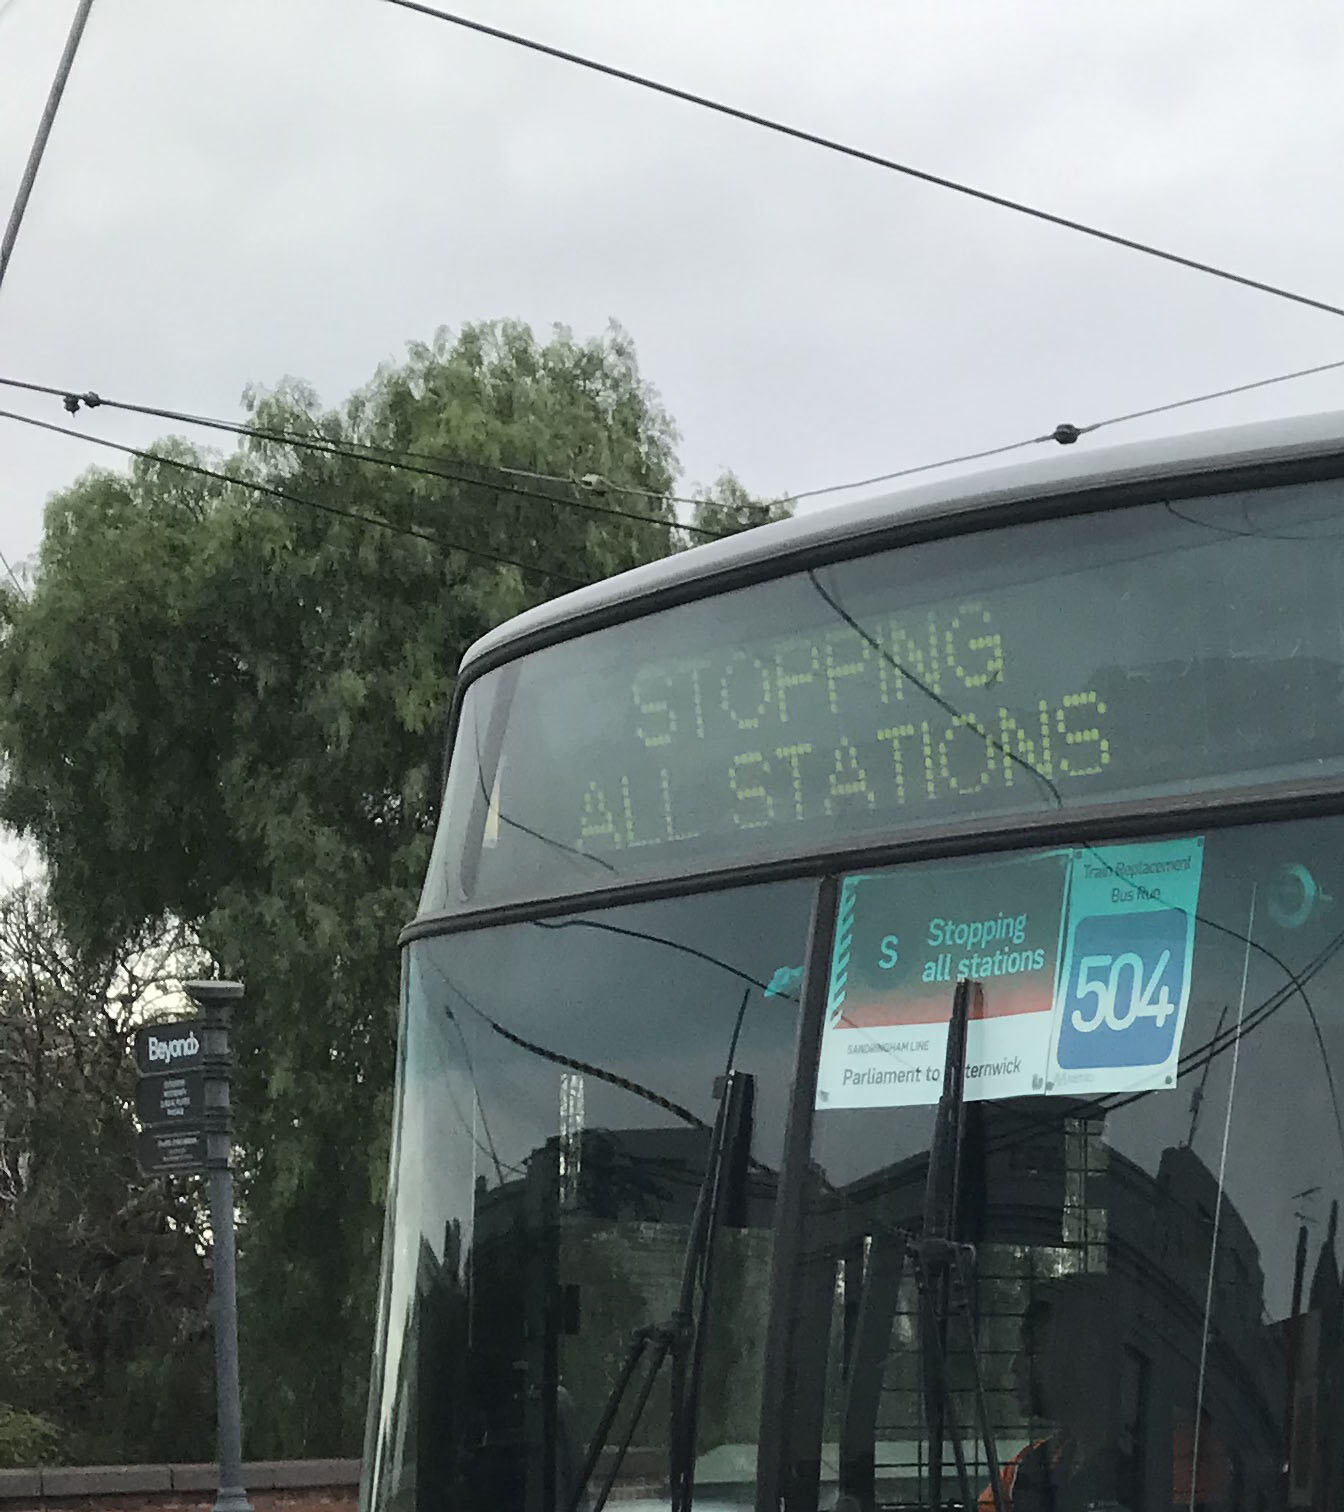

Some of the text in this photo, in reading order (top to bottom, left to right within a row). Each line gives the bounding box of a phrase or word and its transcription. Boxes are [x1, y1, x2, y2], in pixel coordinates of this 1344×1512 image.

[633, 602, 1003, 748] STOPPING
[577, 691, 1110, 849] ALL STATIONS
[1082, 855, 1191, 880] Train Replacement
[1112, 887, 1135, 903] Bus
[927, 911, 1028, 950] Stopping
[878, 935, 899, 969] S
[922, 944, 1045, 983] all stations
[1071, 949, 1175, 1033] 504
[847, 1039, 930, 1055] SANDRINGHAM LINE
[842, 1055, 1022, 1086] Parliament to ternwick
